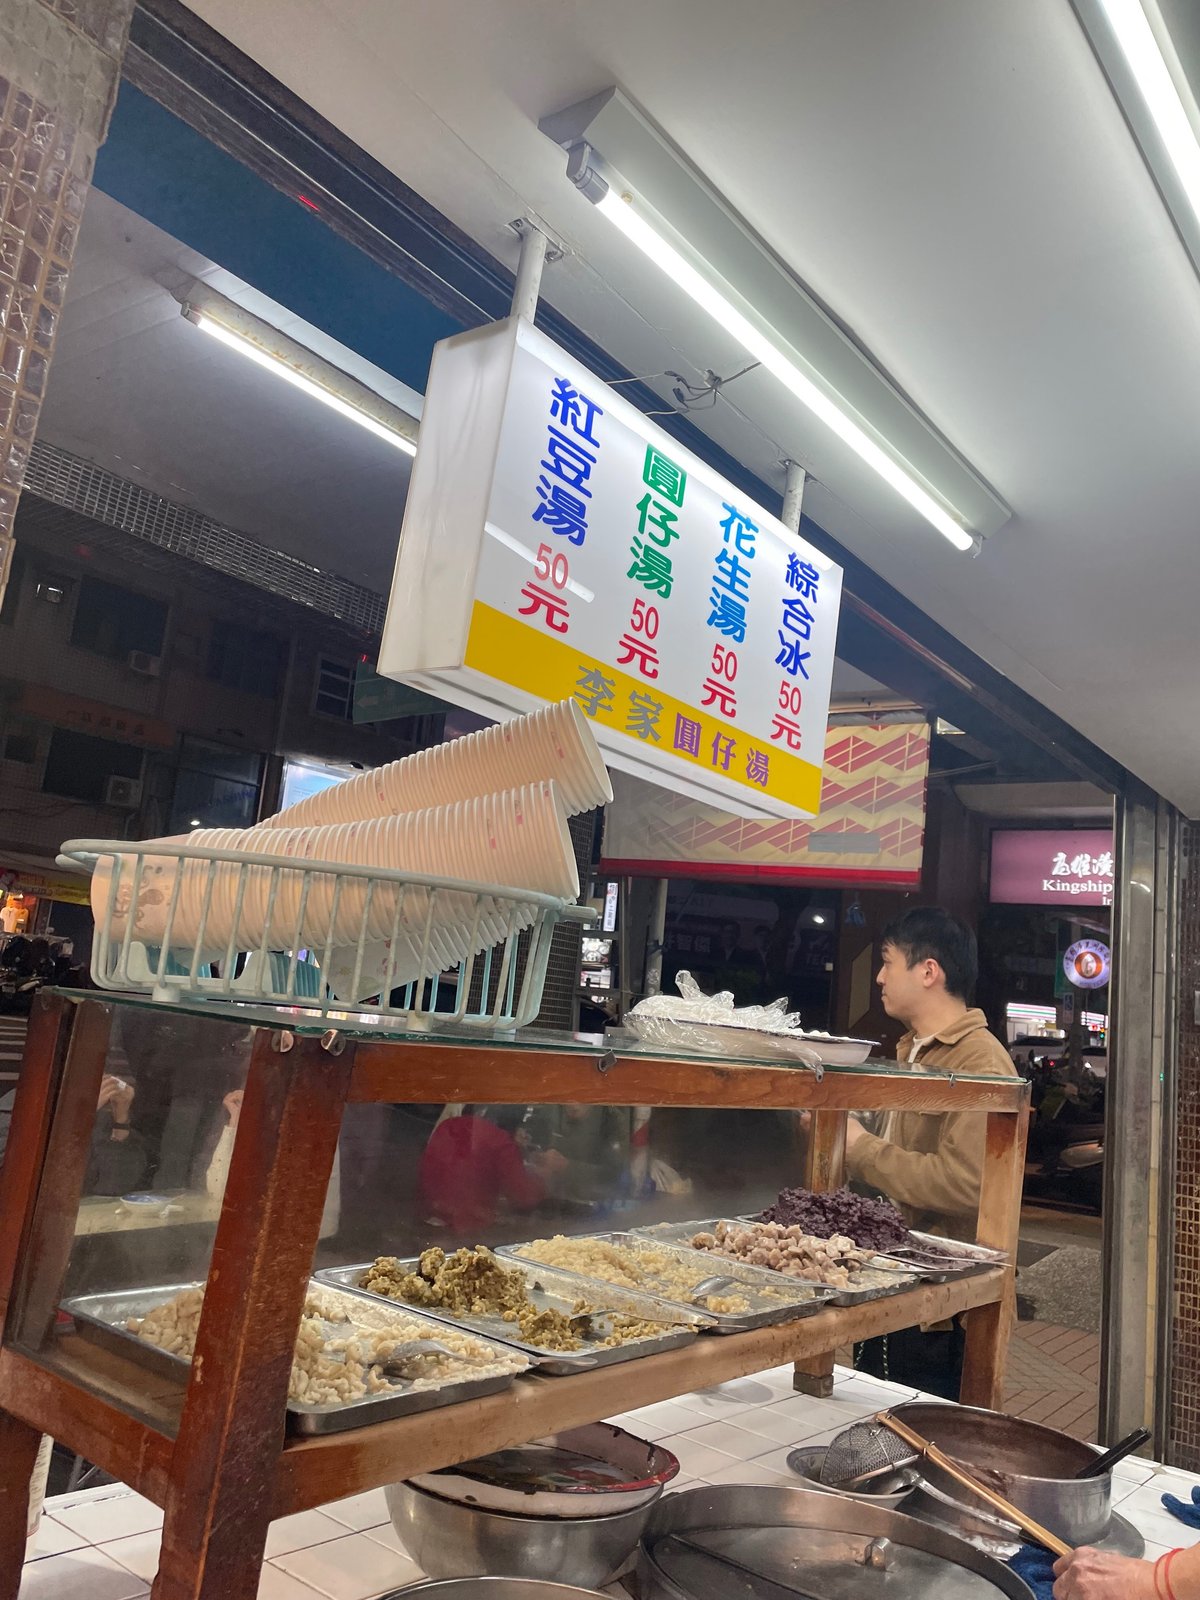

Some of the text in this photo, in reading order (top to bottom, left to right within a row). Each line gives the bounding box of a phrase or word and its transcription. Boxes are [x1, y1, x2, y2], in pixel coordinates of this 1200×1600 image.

[531, 377, 604, 547] 紅豆湯
[626, 444, 687, 600] 圓仔湯
[706, 500, 760, 644] 花生湯
[774, 551, 820, 680] 綜合冰
